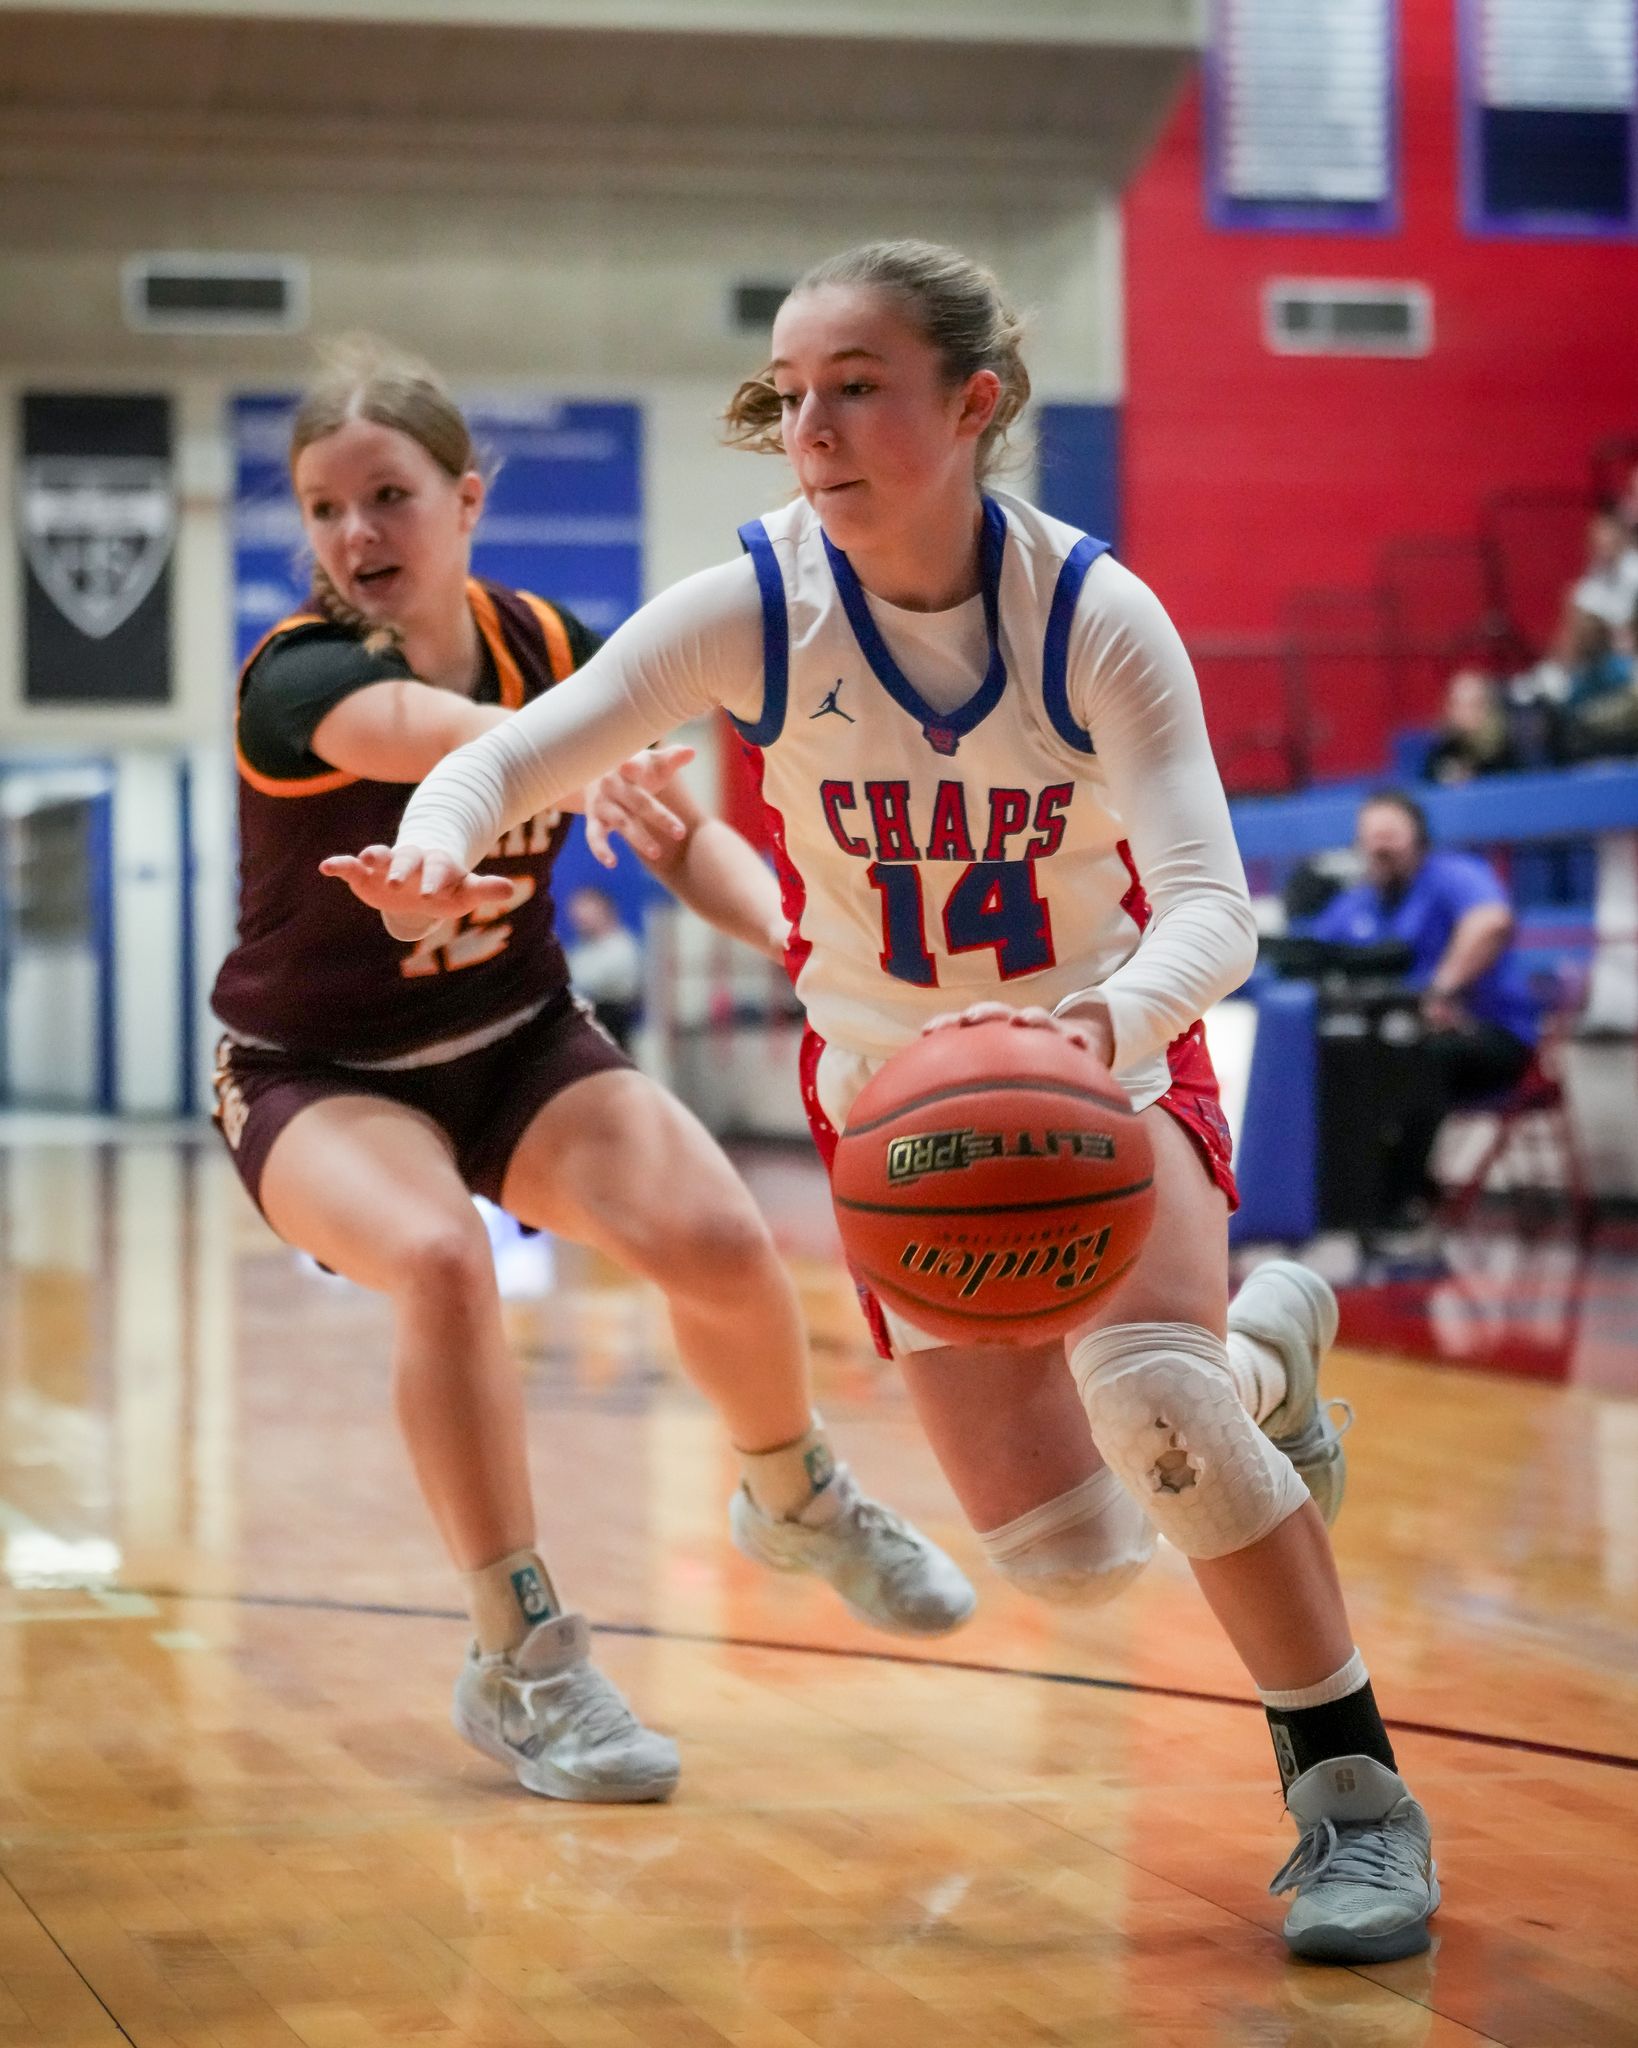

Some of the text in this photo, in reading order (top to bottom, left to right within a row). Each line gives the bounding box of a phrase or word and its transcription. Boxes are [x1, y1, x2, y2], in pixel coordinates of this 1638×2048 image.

[819, 779, 1075, 862] CHAPS
[866, 858, 1058, 988] 14
[891, 1134, 960, 1177] PRO
[900, 1223, 1114, 1298] Baden
